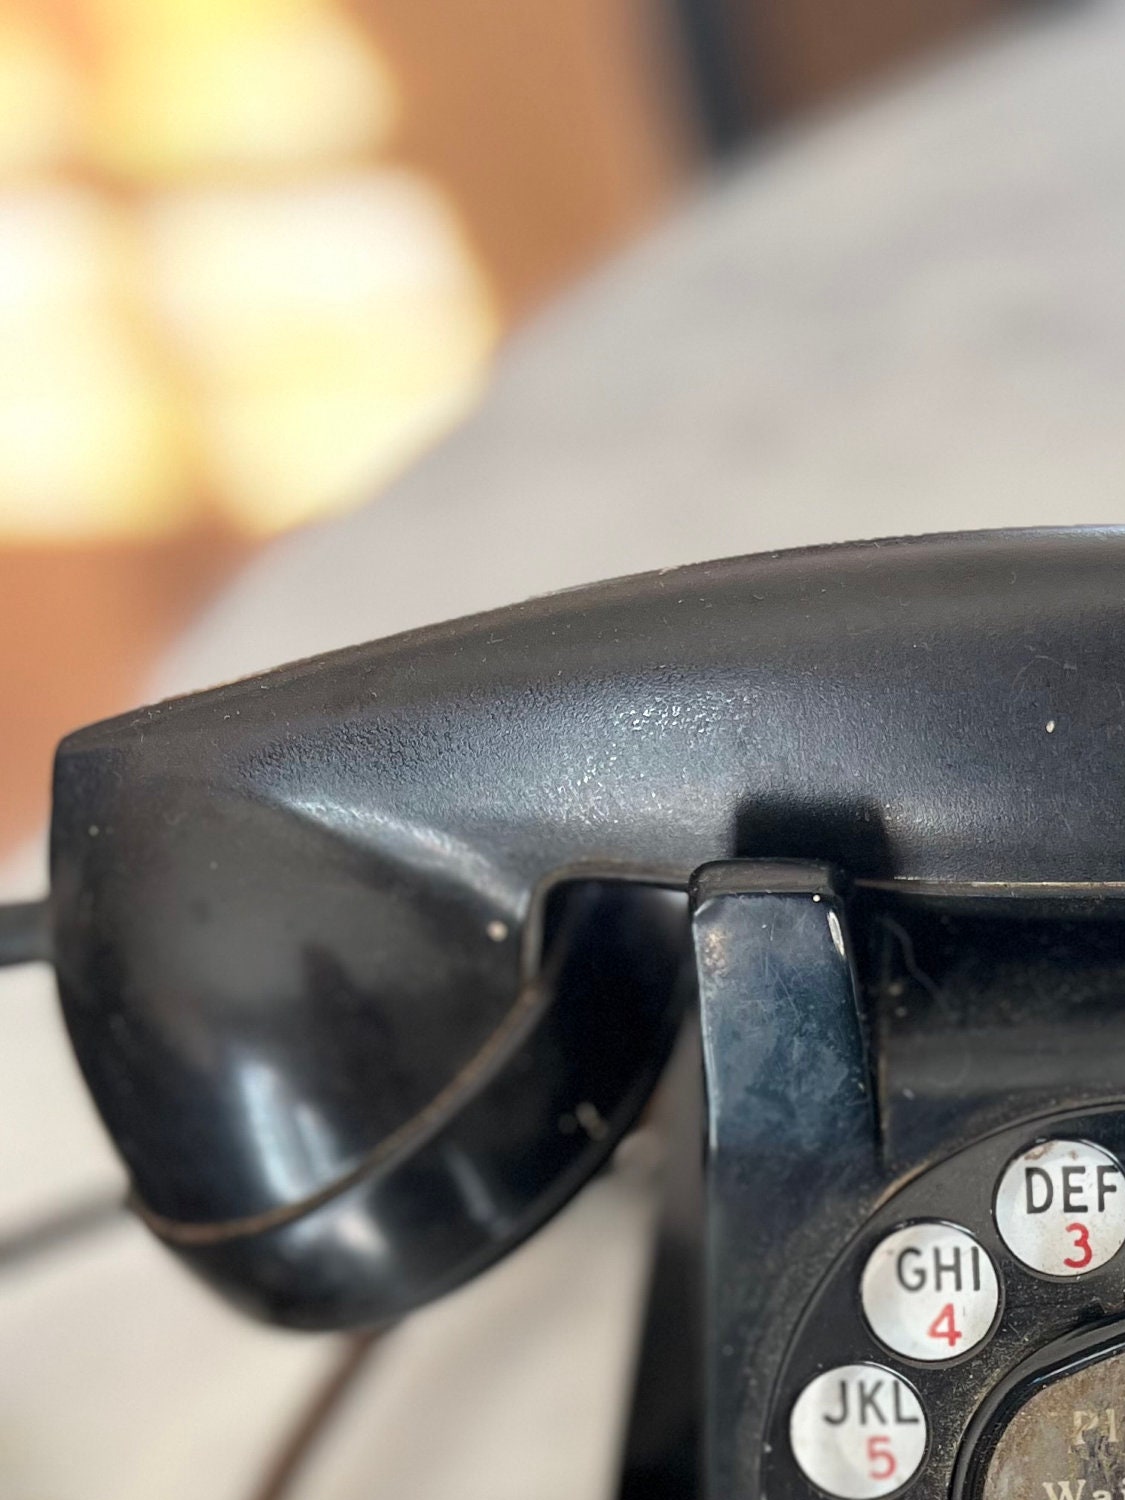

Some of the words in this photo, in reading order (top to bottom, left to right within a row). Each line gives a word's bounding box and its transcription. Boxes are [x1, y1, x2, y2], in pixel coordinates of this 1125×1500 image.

[1025, 1164, 1119, 1214] DEF
[1063, 1222, 1093, 1268] 3
[896, 1246, 981, 1292] GHI
[927, 1303, 962, 1347] 4
[823, 1379, 920, 1425] JKL
[866, 1436, 897, 1479] 5
